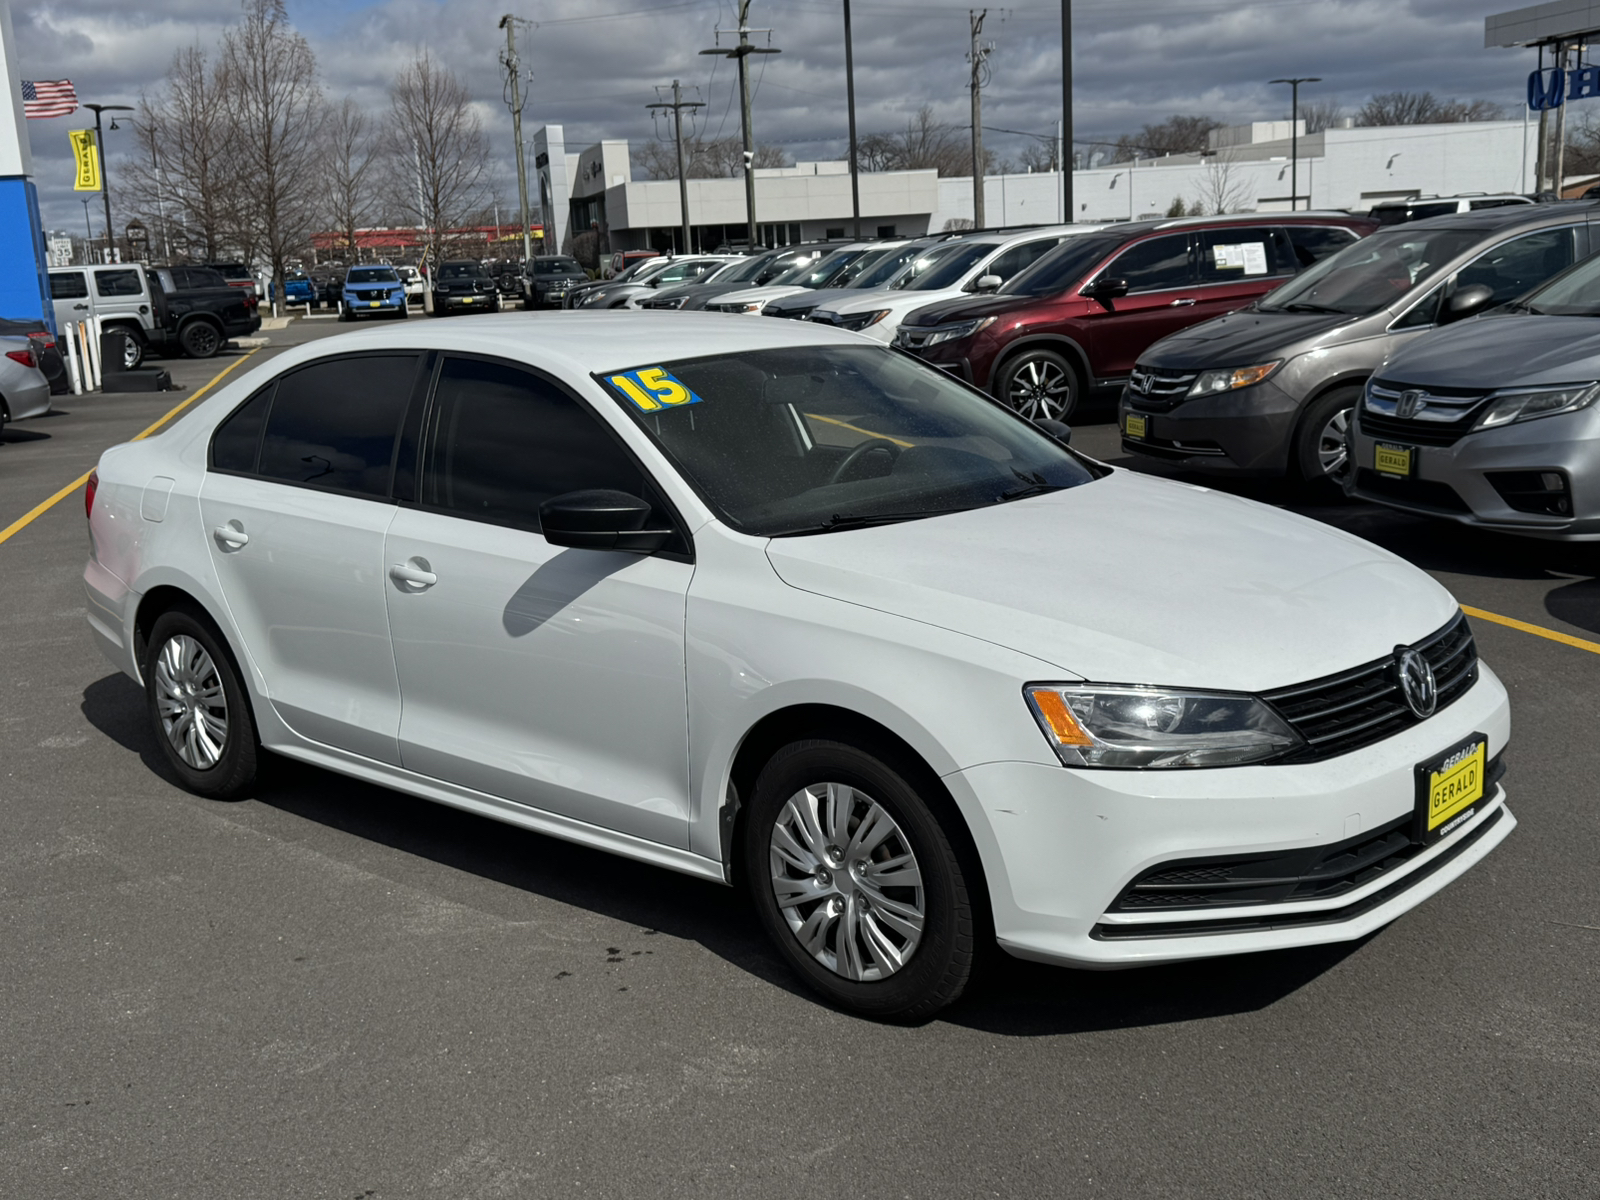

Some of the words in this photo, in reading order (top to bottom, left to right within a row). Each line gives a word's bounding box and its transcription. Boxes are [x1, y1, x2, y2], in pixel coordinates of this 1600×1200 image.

[80, 137, 91, 183] GERALD
[57, 248, 71, 256] 35
[611, 368, 691, 411] 15
[1380, 455, 1406, 467] GERALD
[1442, 742, 1477, 771] GERALD
[1433, 769, 1475, 808] GERALD
